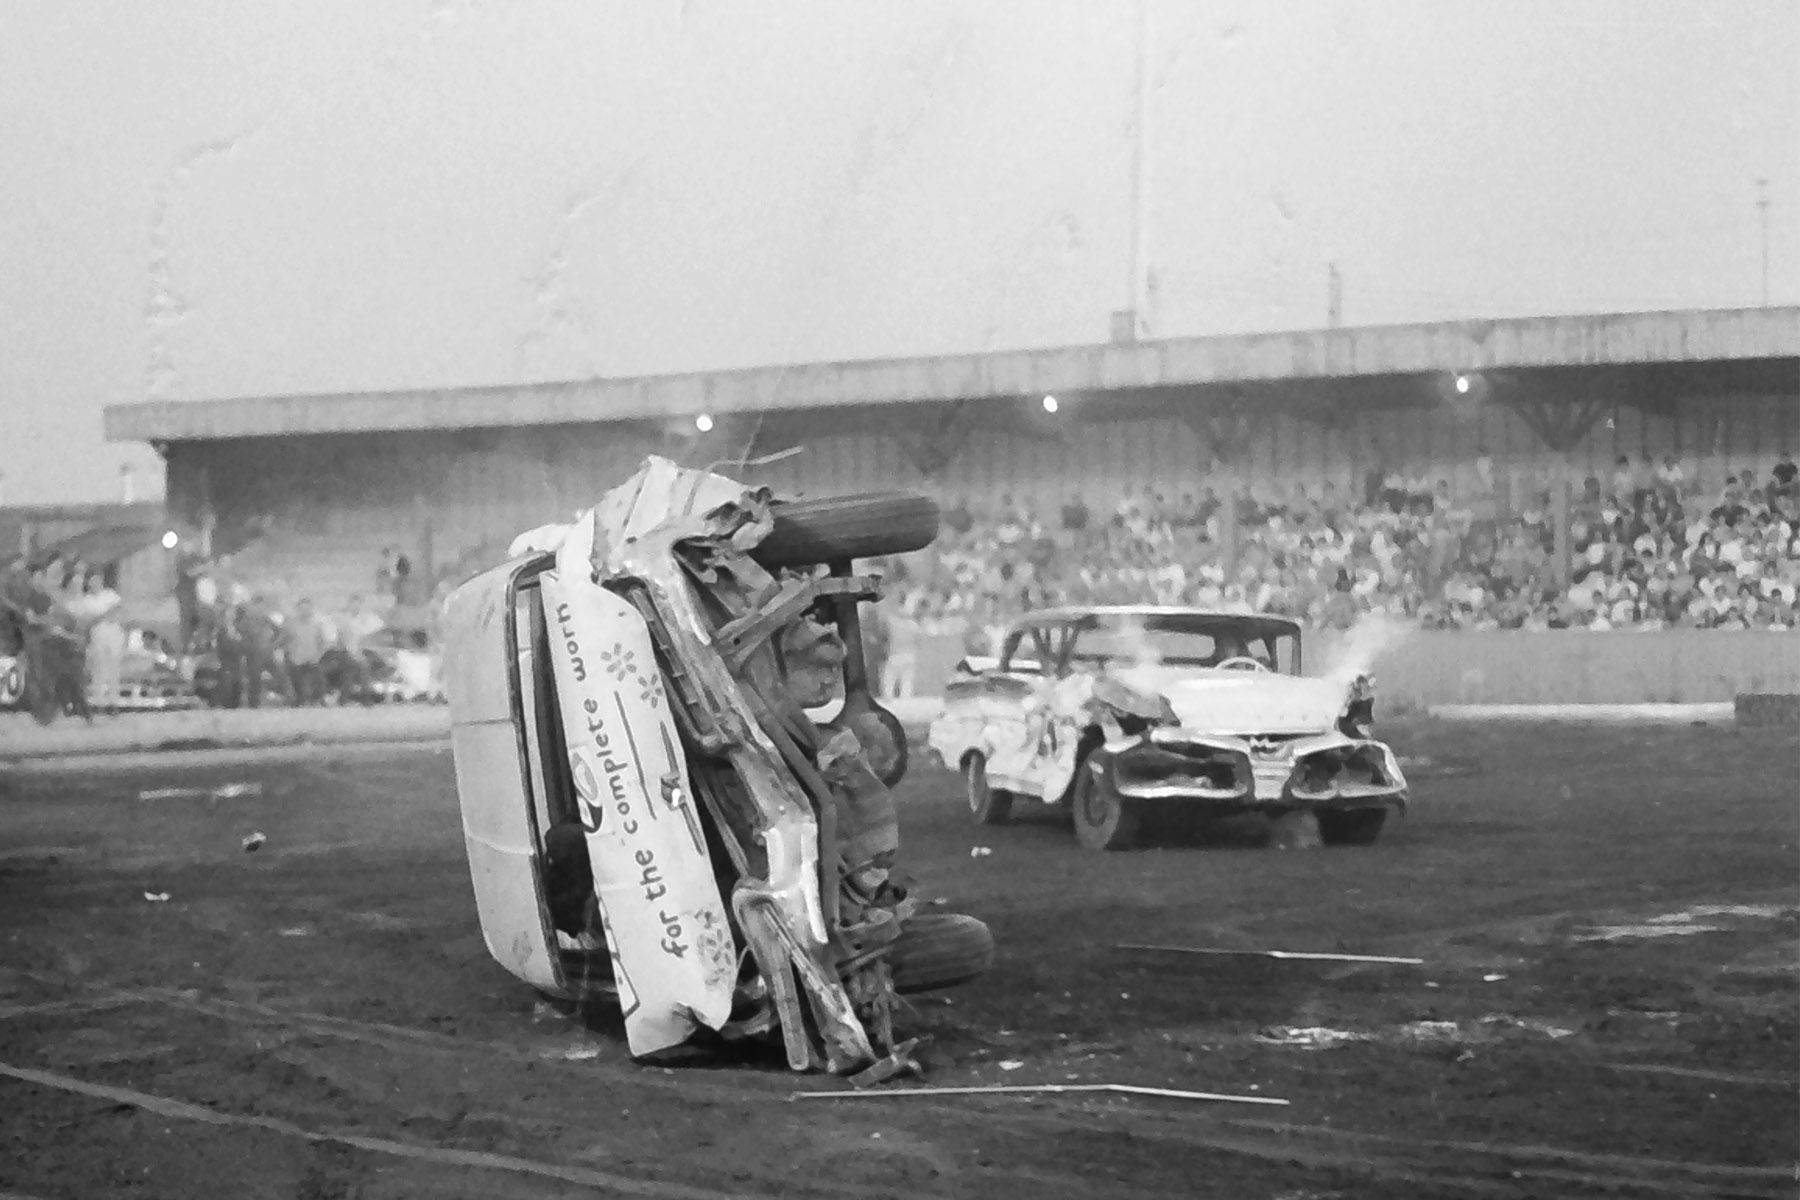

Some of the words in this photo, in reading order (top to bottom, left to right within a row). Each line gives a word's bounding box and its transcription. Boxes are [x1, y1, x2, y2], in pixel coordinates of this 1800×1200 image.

[556, 603, 586, 681] worn
[584, 699, 638, 834] complete
[635, 849, 666, 901] the
[660, 910, 688, 958] for
